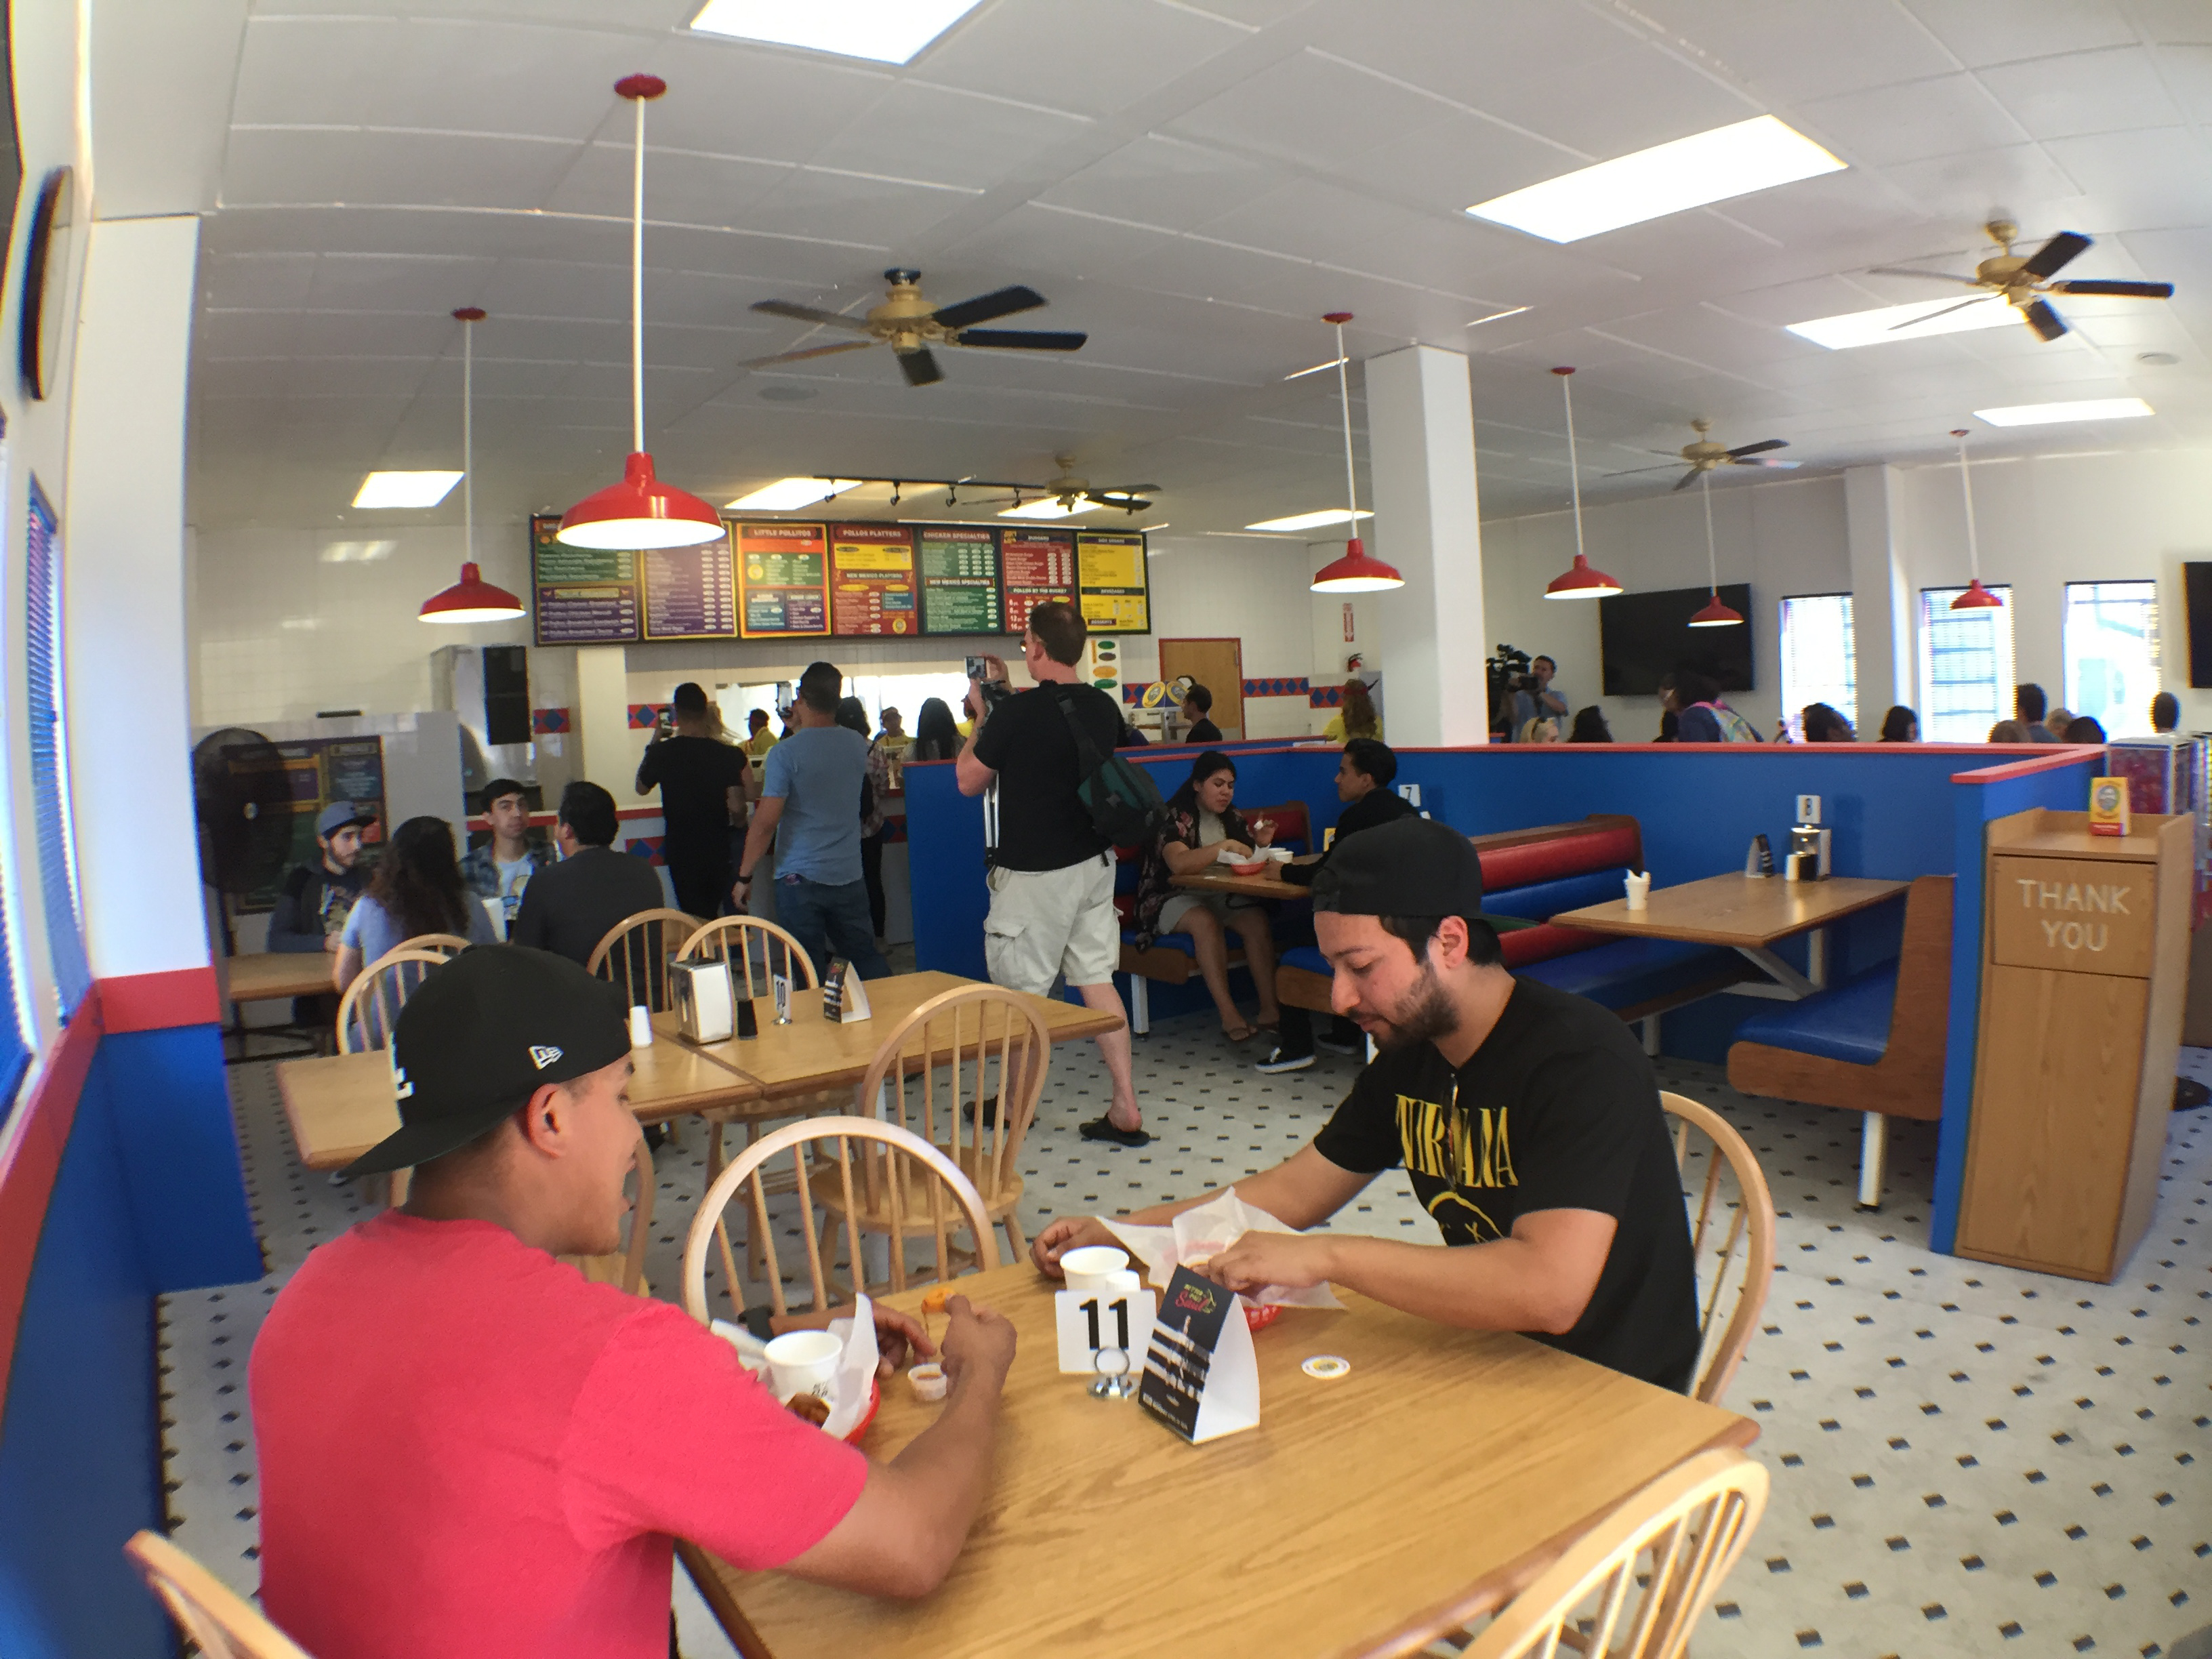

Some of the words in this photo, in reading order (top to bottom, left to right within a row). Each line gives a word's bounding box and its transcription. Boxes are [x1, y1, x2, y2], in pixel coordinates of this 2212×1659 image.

[2016, 878, 2131, 915] THANK
[2041, 920, 2109, 951] YOU
[1080, 1297, 1129, 1350] 11
